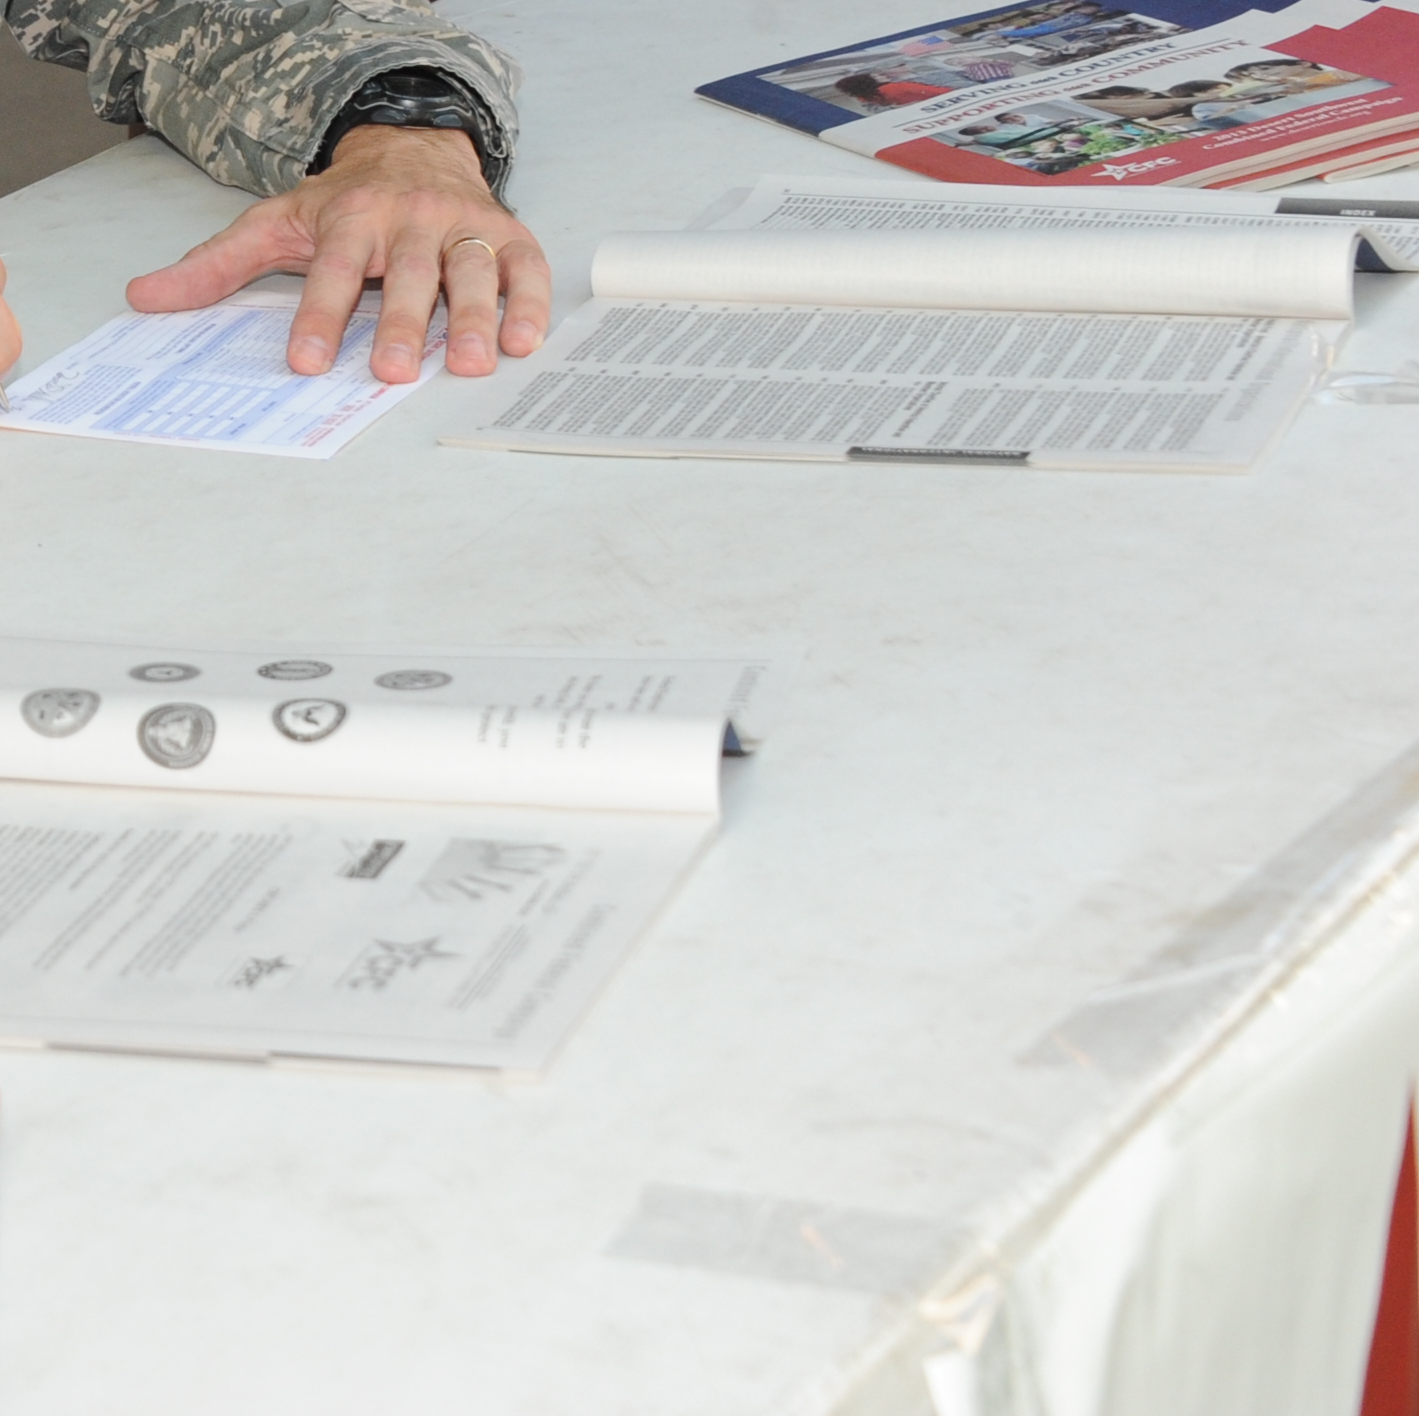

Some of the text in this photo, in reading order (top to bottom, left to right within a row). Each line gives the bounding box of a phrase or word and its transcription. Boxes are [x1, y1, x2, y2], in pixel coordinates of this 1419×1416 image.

[902, 89, 1061, 134] SUPPORTING
[1091, 39, 1250, 84] COMMUNITY
[920, 82, 1028, 114] SERVING
[1058, 41, 1178, 77] COUNTRY
[1201, 95, 1404, 151] Combined Federal Campaign
[1247, 116, 1296, 133] Desert
[1293, 97, 1368, 119] Southwest
[1126, 156, 1178, 173] CFC
